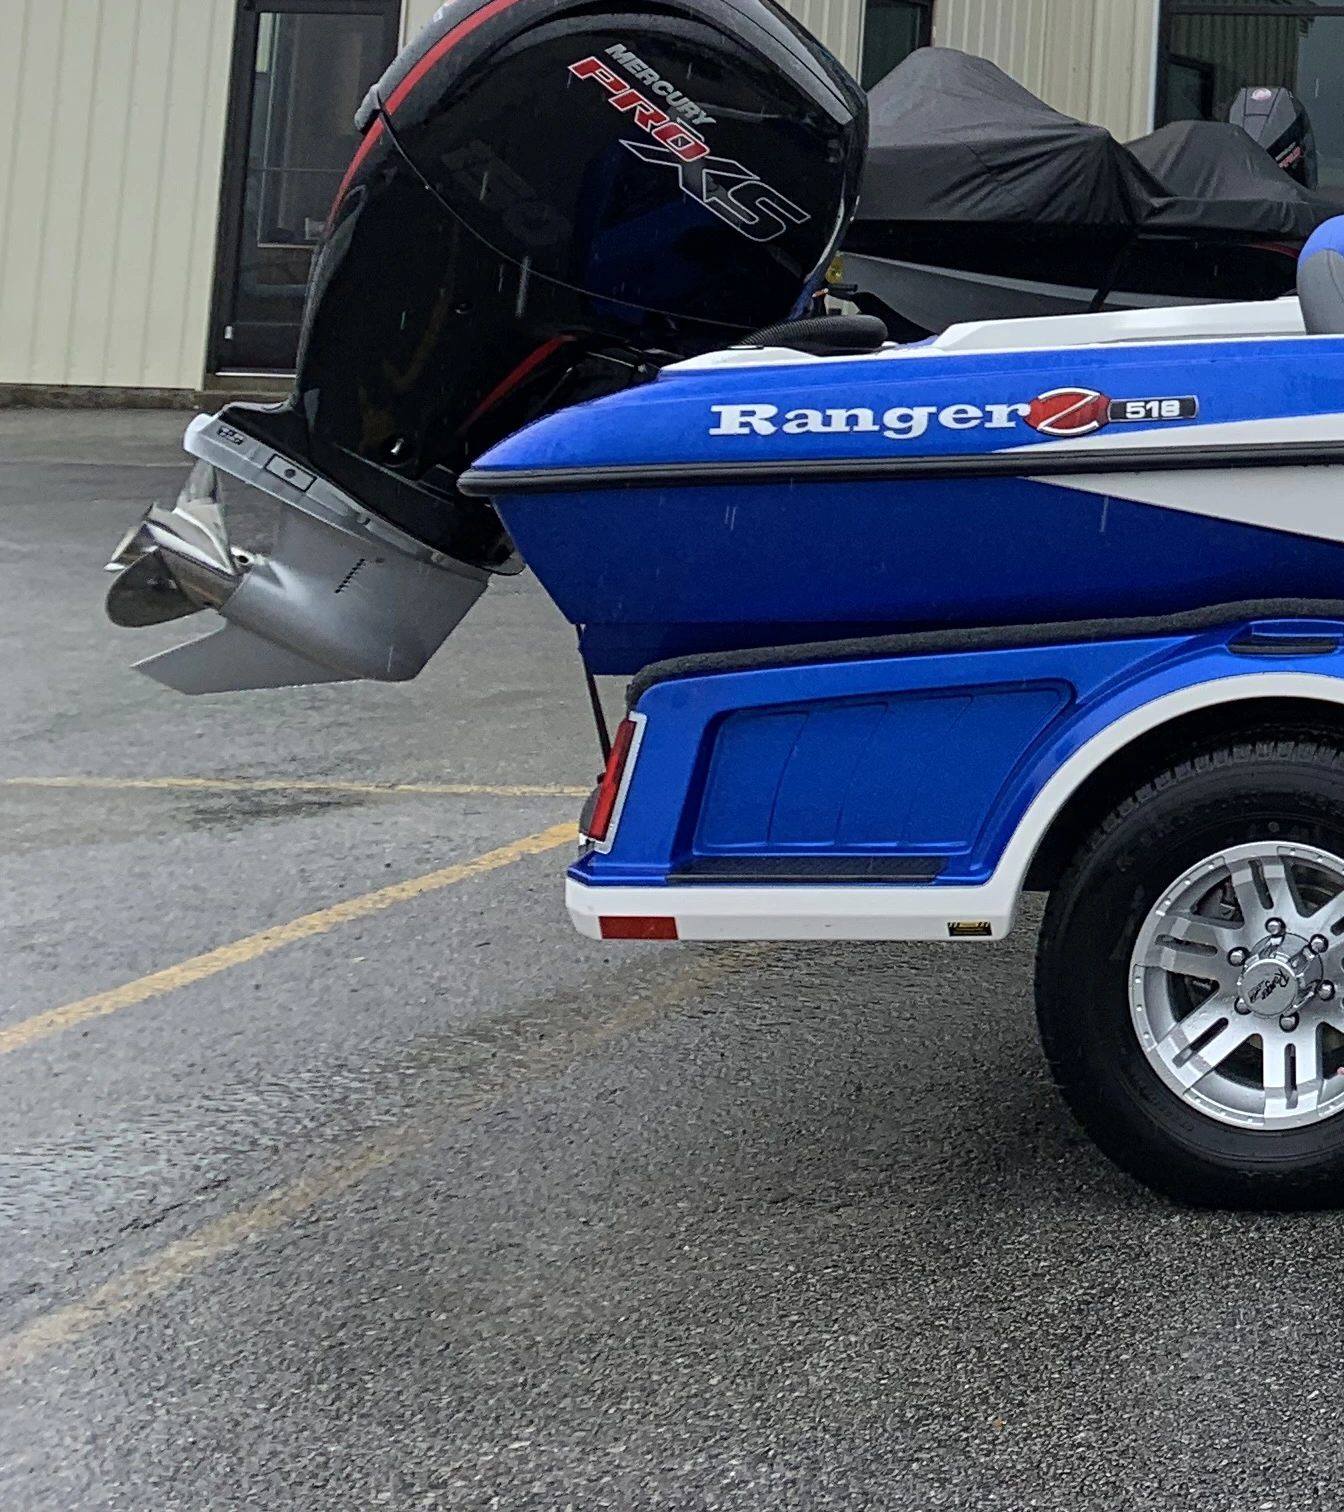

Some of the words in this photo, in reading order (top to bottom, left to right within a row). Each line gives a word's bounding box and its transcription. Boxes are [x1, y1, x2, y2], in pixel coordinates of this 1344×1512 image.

[568, 56, 711, 162] PRO
[604, 43, 717, 125] MERCURY
[618, 118, 812, 243] XS
[708, 401, 1031, 439] Ranger
[1125, 399, 1181, 419] 518
